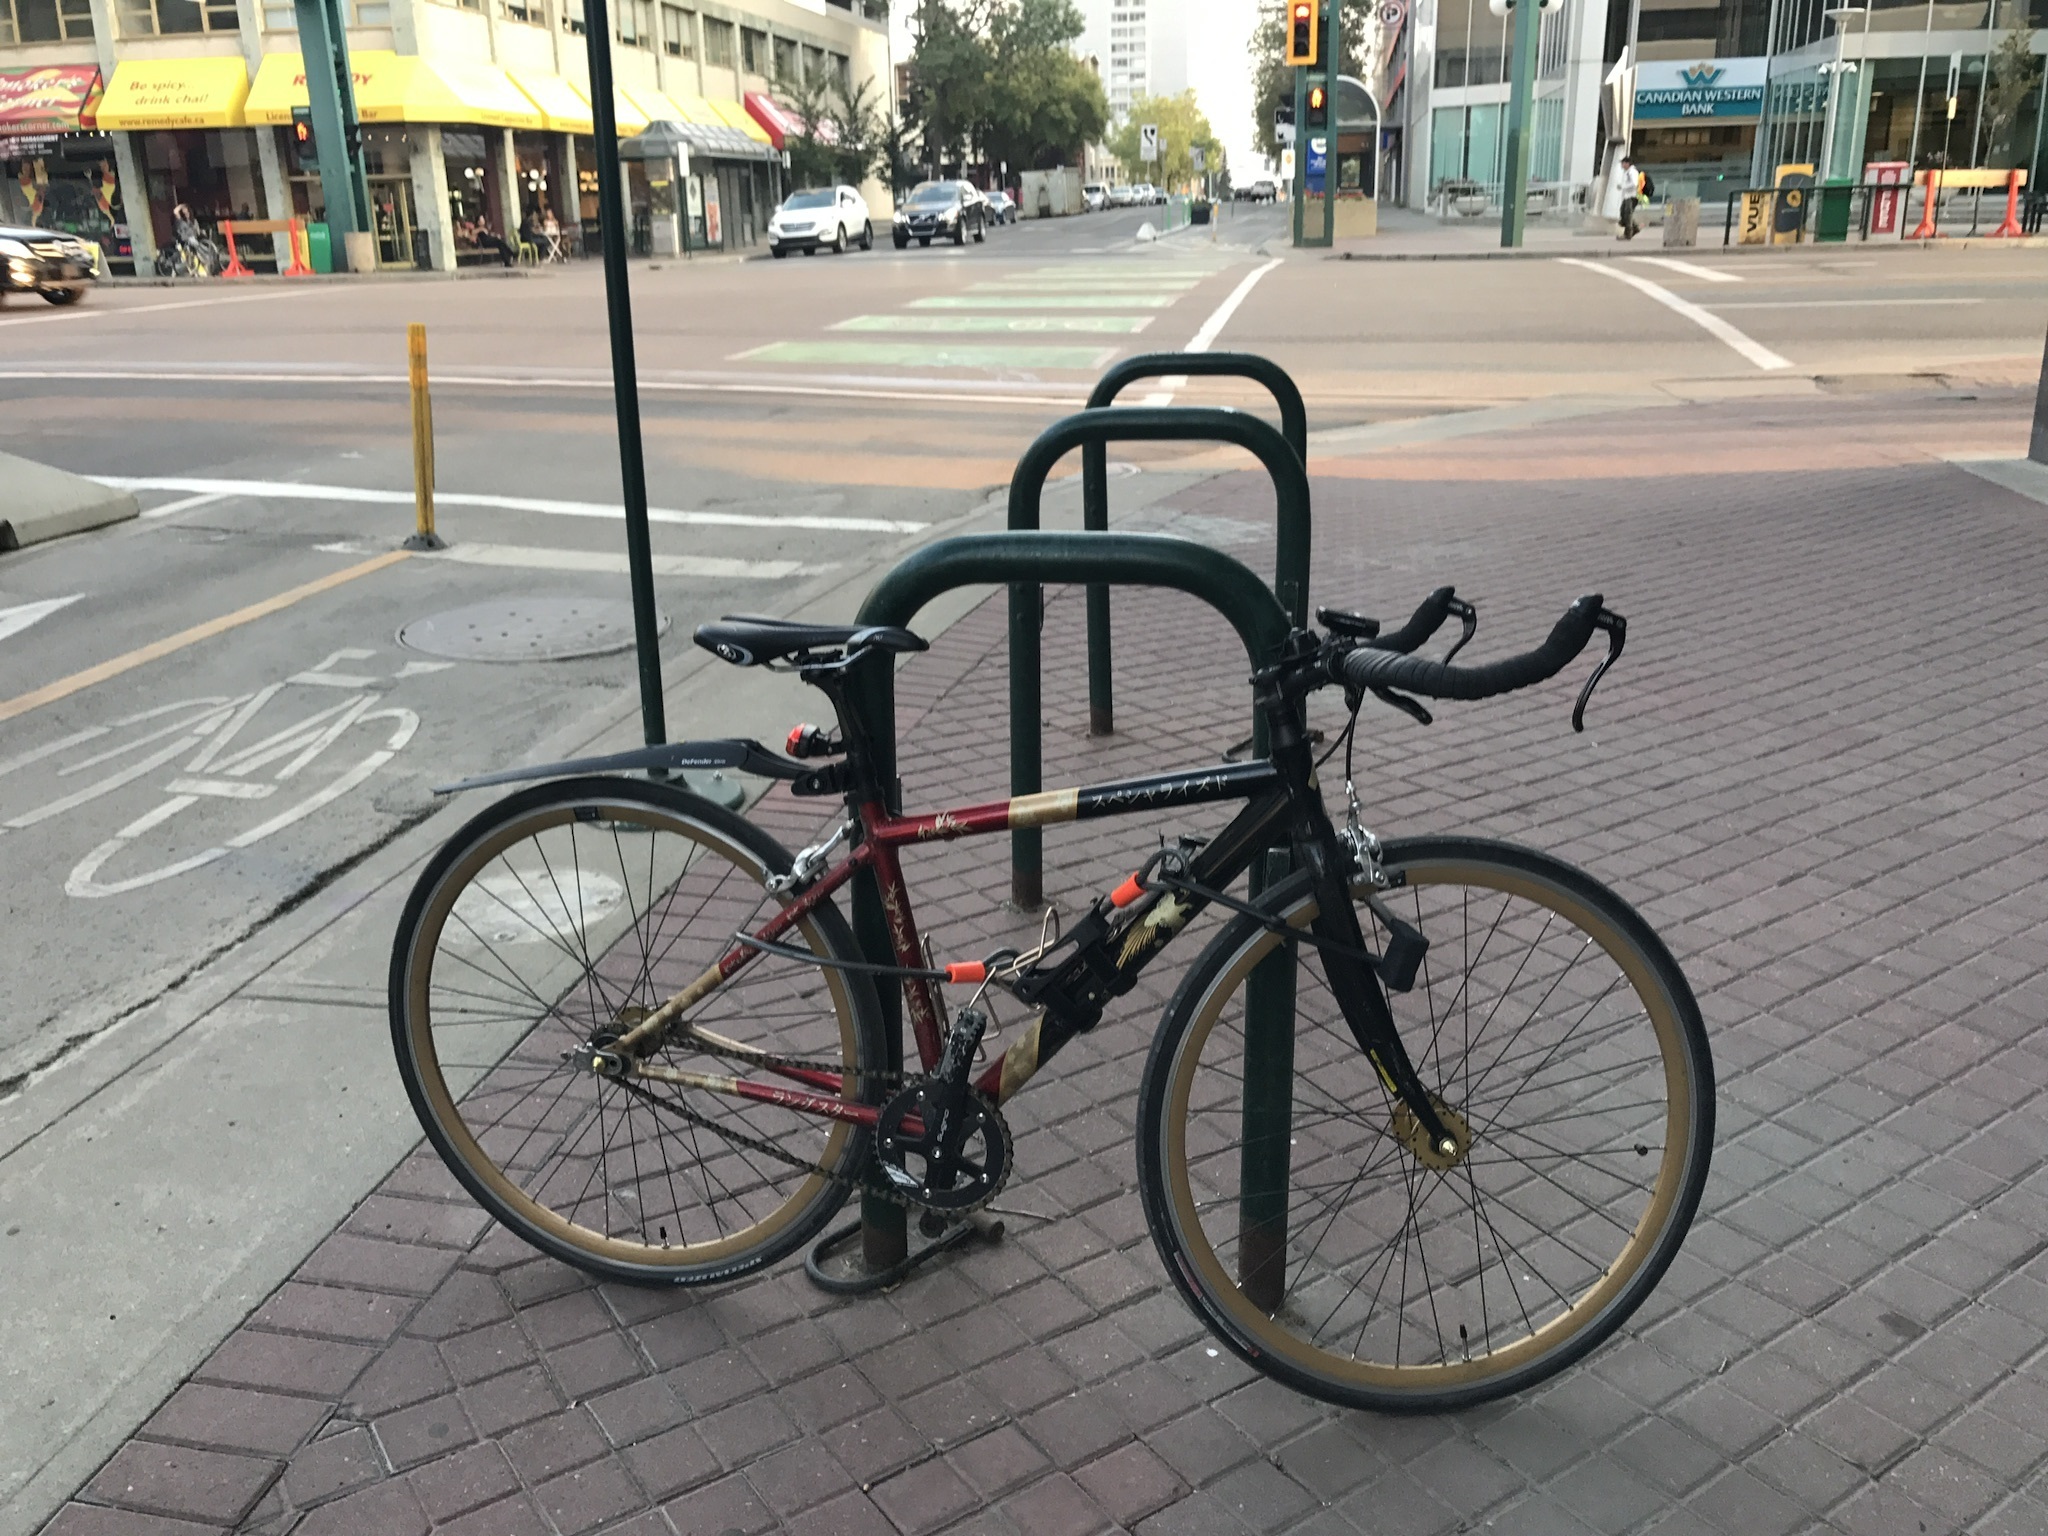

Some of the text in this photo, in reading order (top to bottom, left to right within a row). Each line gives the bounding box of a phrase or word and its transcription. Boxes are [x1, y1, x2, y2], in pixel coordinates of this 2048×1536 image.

[135, 93, 209, 105] drink chai!
[1637, 90, 1700, 104] CANADIAN
[1704, 88, 1762, 101] WESTERN
[361, 109, 377, 119] Bar
[1681, 103, 1715, 116] BANK
[1746, 193, 1761, 233] VUE
